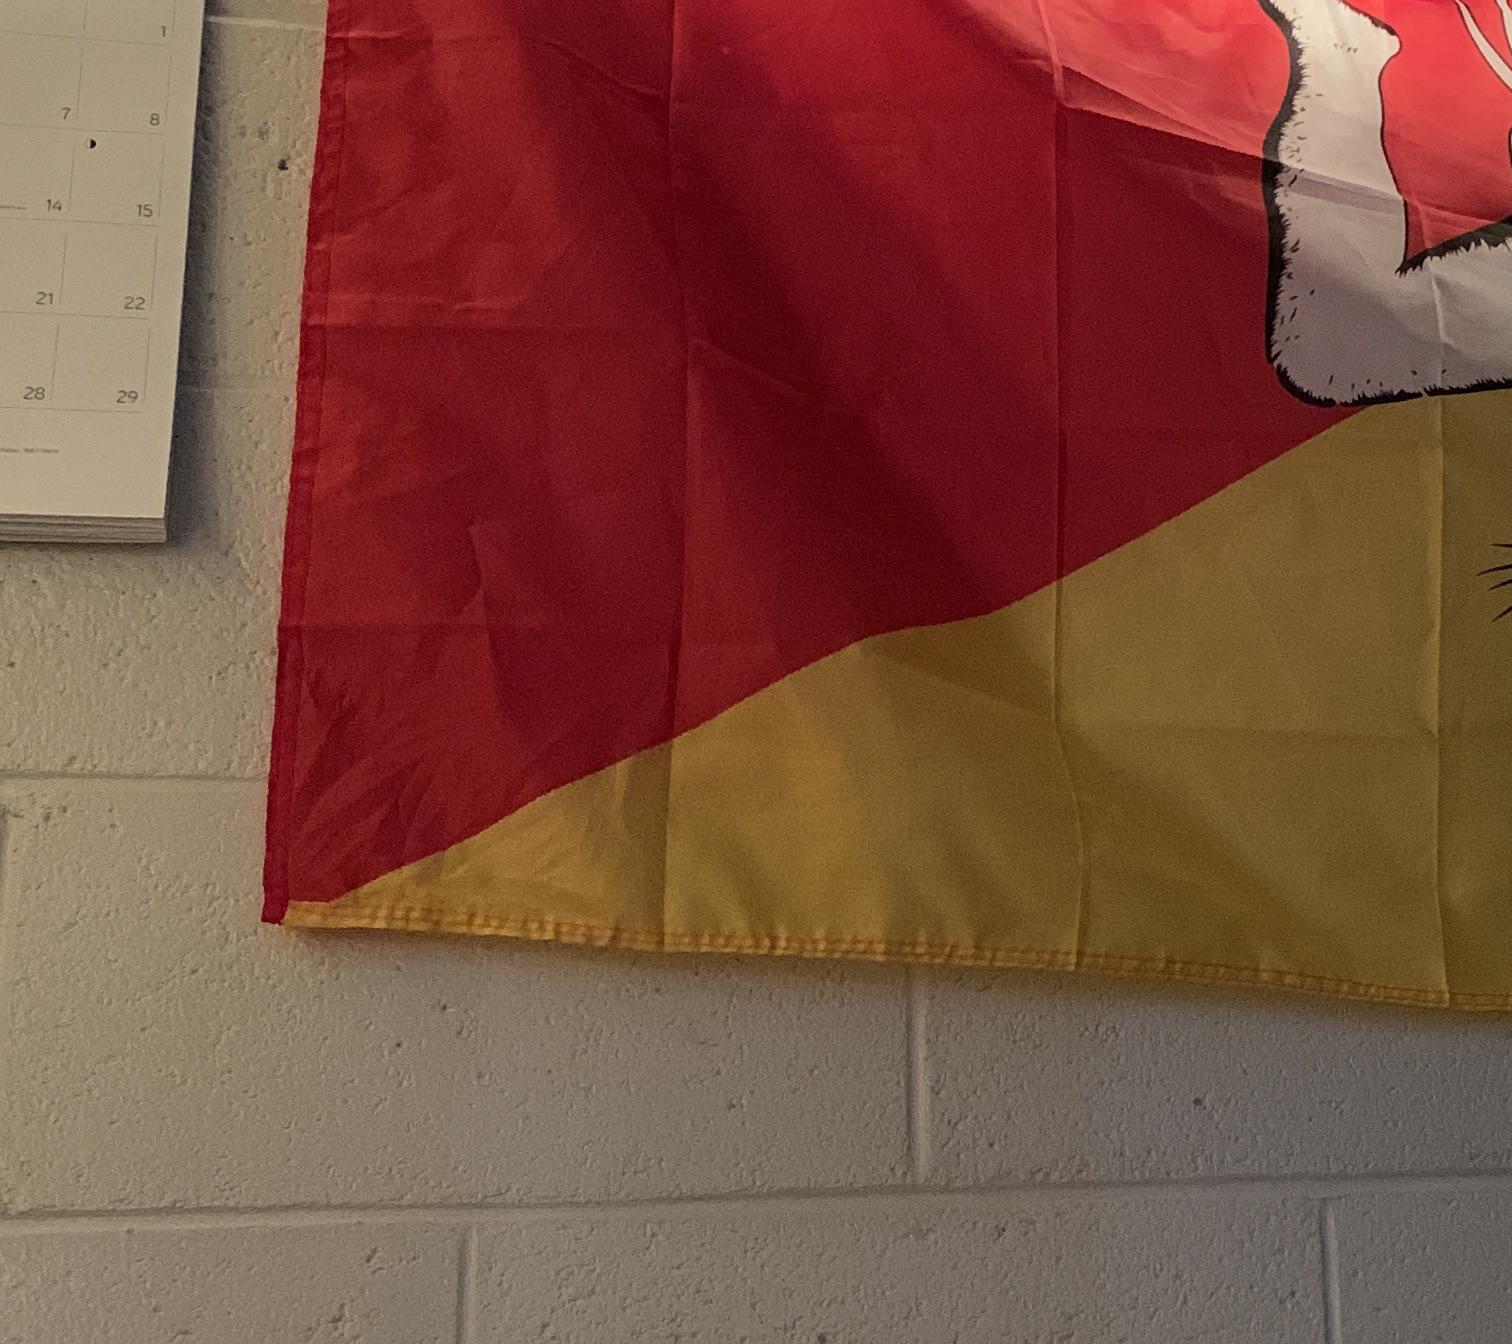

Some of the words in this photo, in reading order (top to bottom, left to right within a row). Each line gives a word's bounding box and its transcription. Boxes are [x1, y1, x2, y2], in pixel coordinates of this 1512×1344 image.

[160, 25, 167, 37] 1
[61, 107, 71, 120] 7
[149, 112, 160, 126] 8
[46, 199, 62, 212] 14
[136, 203, 153, 218] 15
[35, 291, 54, 305] 21
[123, 295, 146, 311] 22
[23, 386, 46, 401] 28
[116, 390, 139, 404] 29
